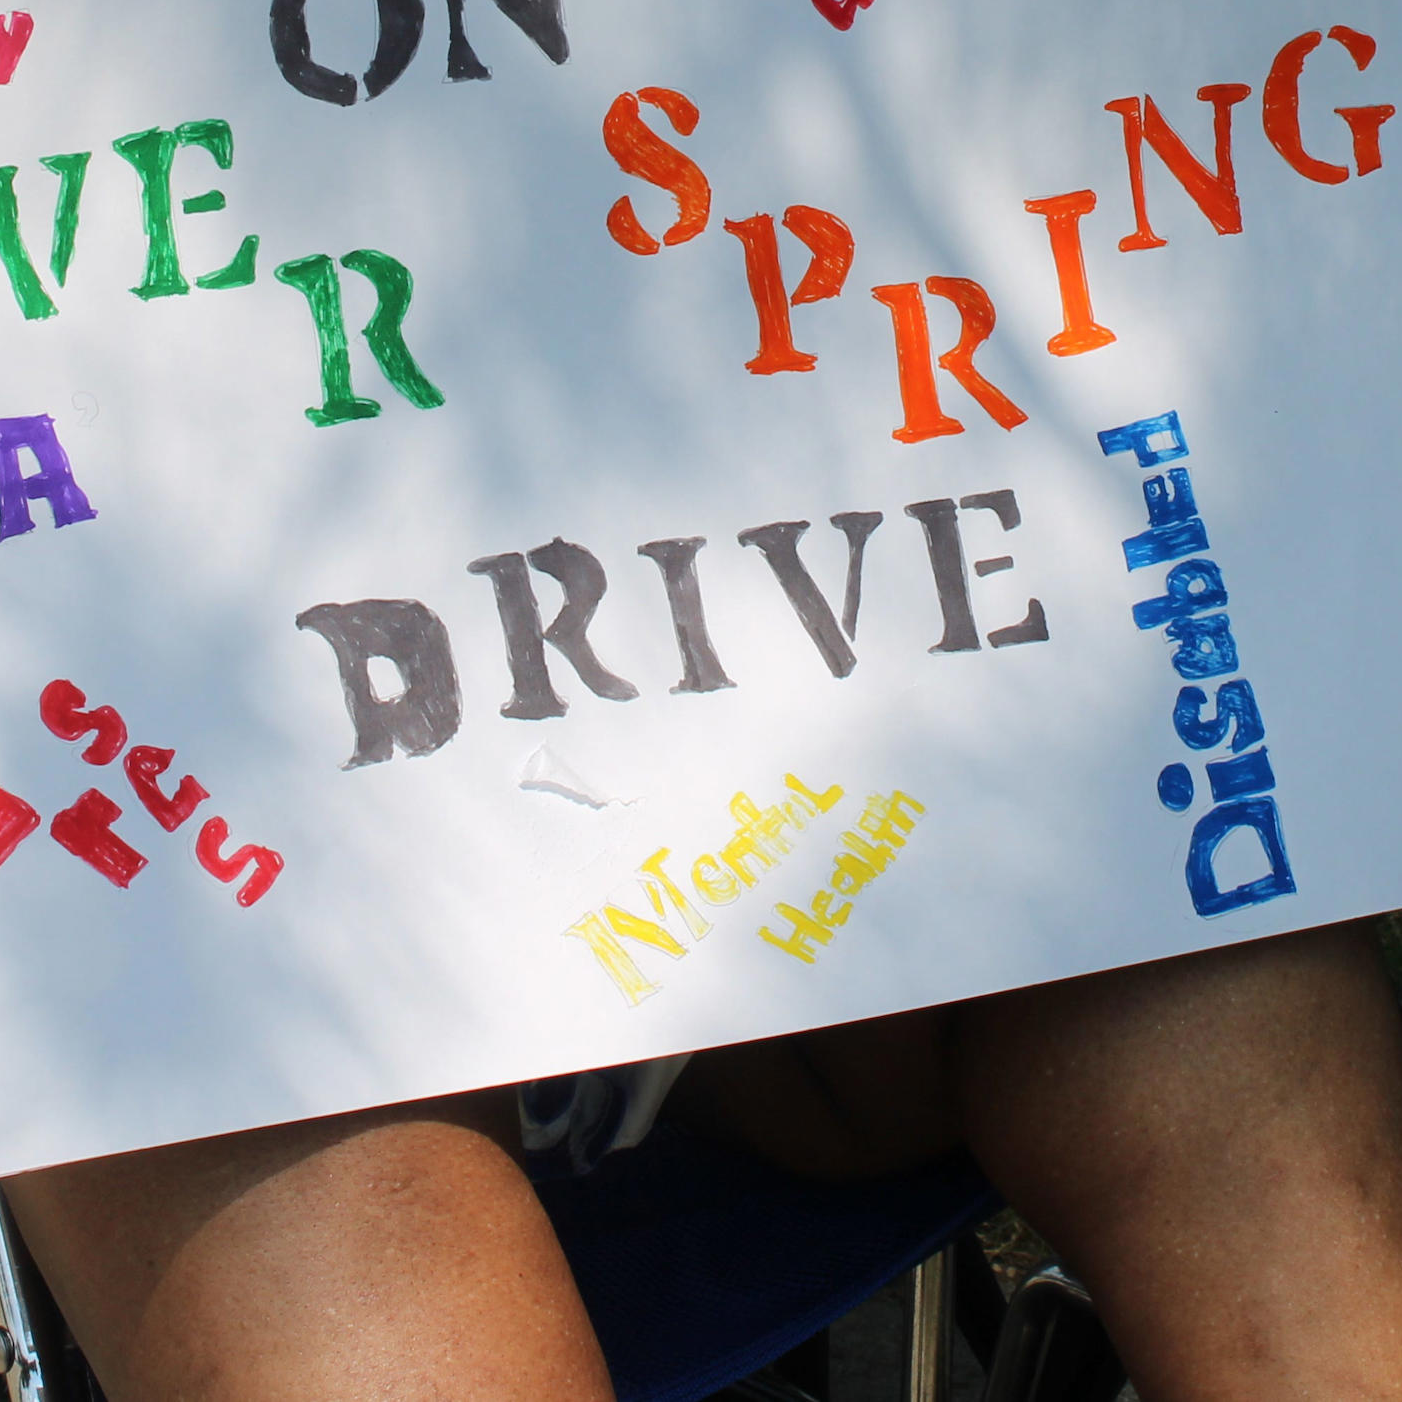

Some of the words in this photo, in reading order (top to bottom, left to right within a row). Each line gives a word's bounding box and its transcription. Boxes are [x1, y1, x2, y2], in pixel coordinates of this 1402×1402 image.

[603, 24, 1395, 443] SPRING
[295, 488, 1050, 769] DRIVE
[1097, 410, 1297, 917] Disabled
[756, 789, 927, 965] Health
